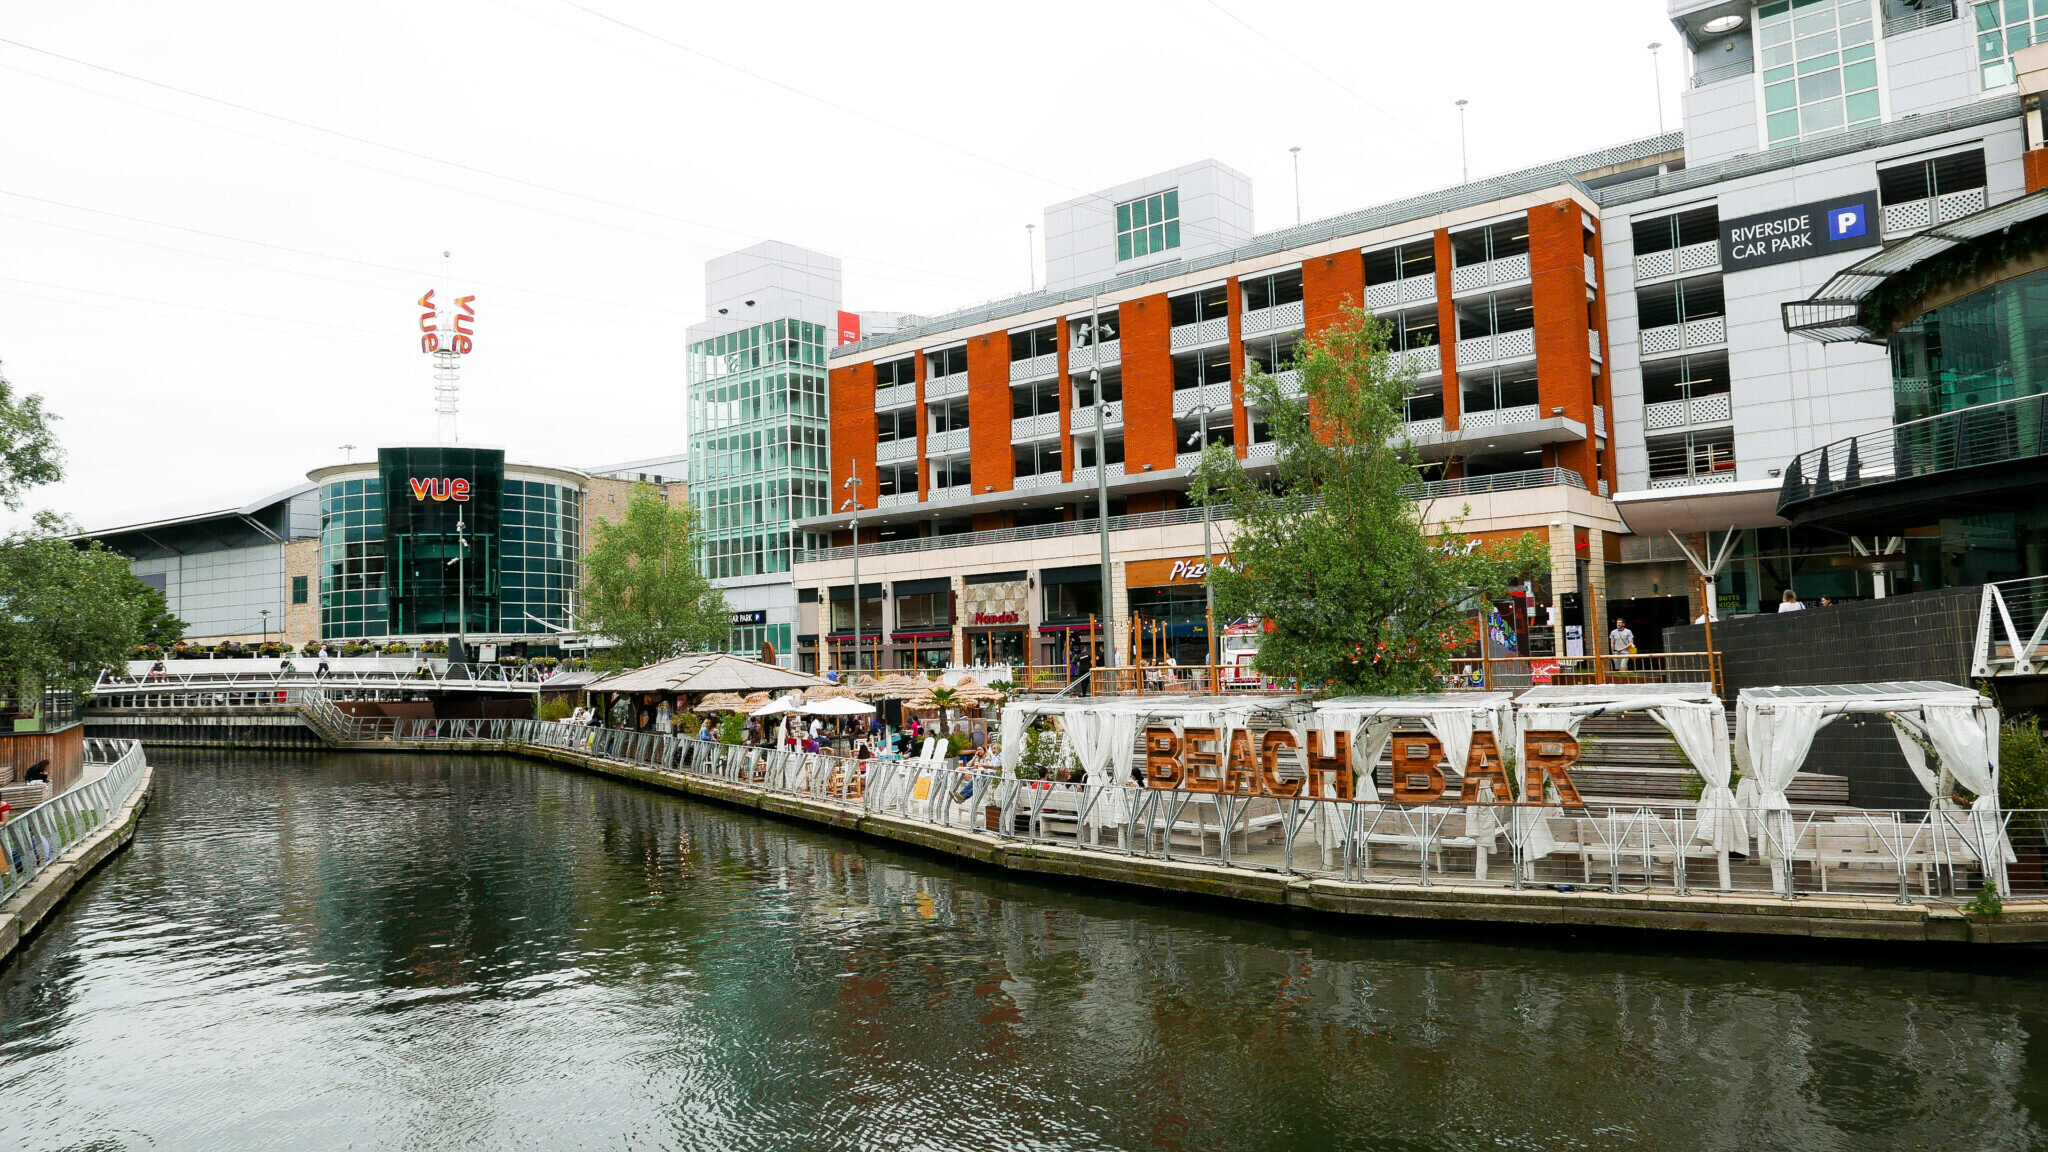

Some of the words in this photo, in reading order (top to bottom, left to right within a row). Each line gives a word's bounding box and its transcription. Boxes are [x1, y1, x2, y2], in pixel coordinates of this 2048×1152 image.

[1731, 214, 1810, 243] RIVERSIDE
[1838, 212, 1857, 234] P
[1732, 243, 1766, 259] CAR
[1772, 232, 1812, 252] PARK
[1169, 559, 1213, 581] Pizz
[740, 613, 753, 622] PARK
[975, 610, 1019, 625] Nando's
[1146, 726, 1353, 801] BEACH
[1391, 729, 1584, 805] BAR
